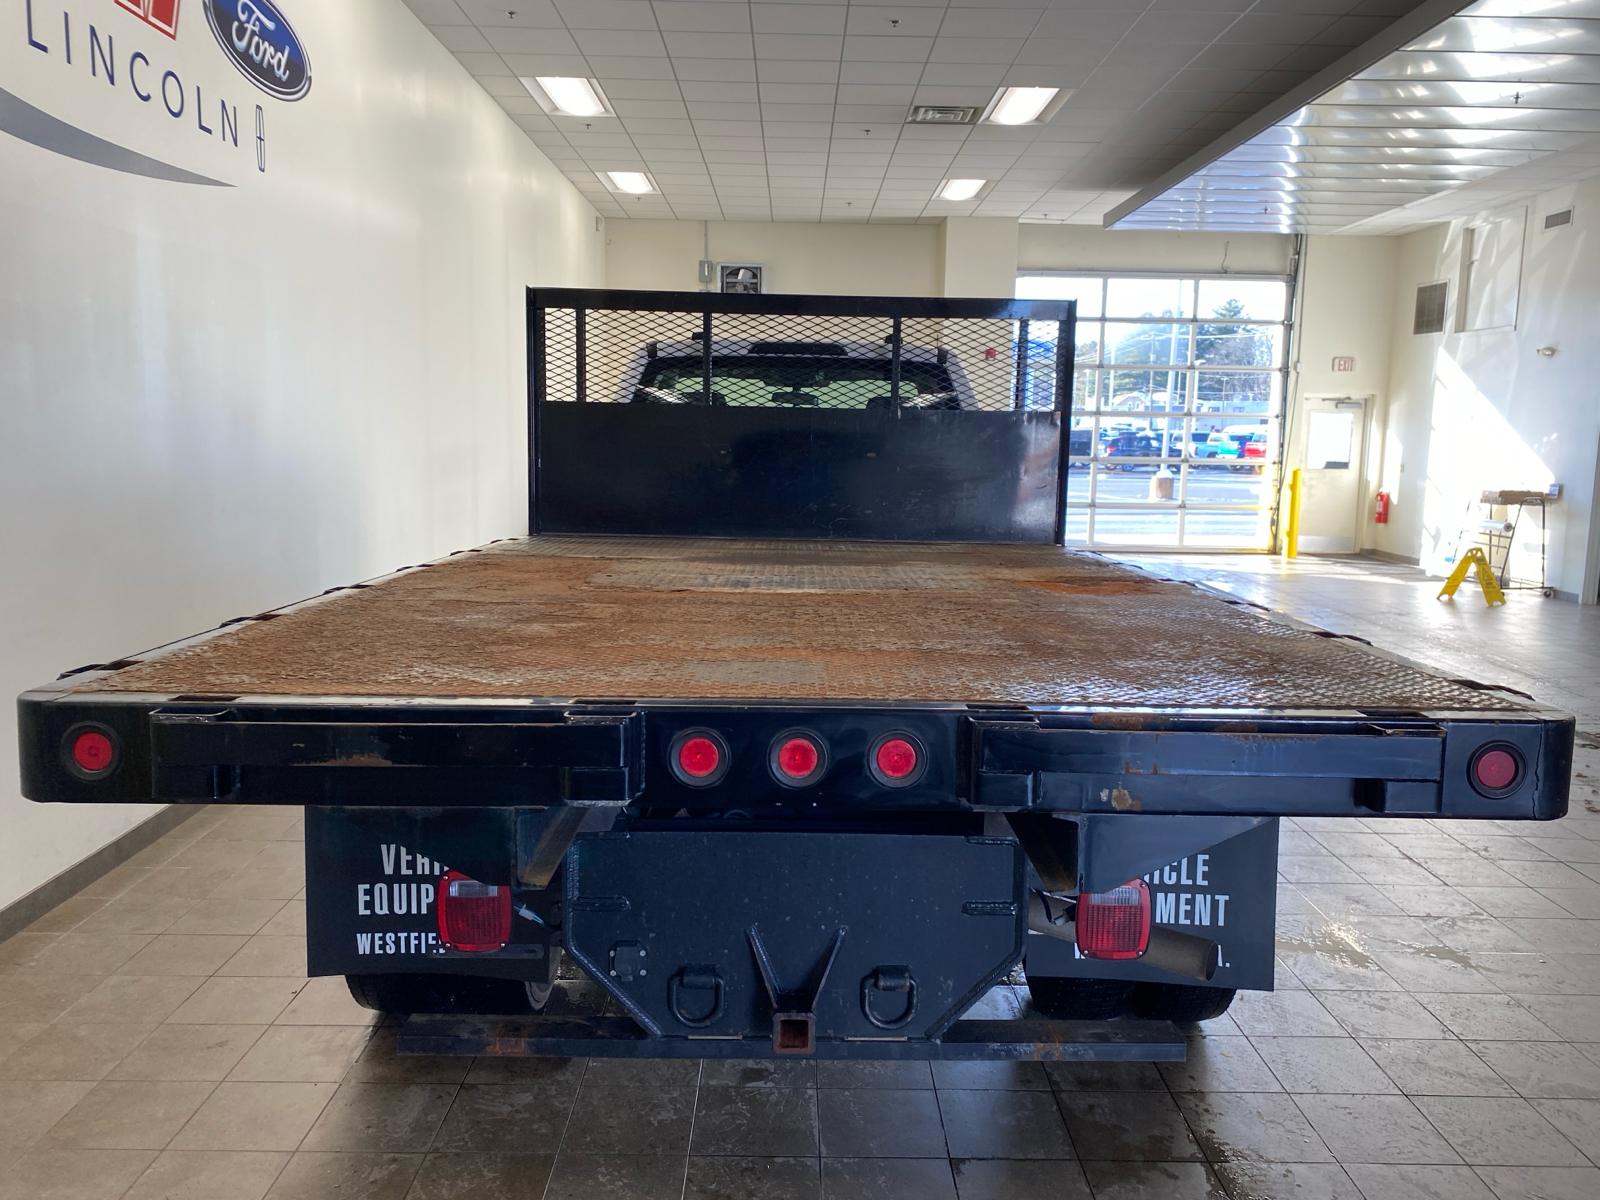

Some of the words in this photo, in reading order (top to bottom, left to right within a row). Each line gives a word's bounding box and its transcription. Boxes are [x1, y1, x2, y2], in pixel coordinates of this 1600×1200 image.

[232, 0, 290, 82] Ford
[26, 0, 238, 148] LINCOLN
[1337, 359, 1354, 372] EXIT
[357, 883, 435, 916] EQUIP
[1155, 892, 1230, 927] MENT
